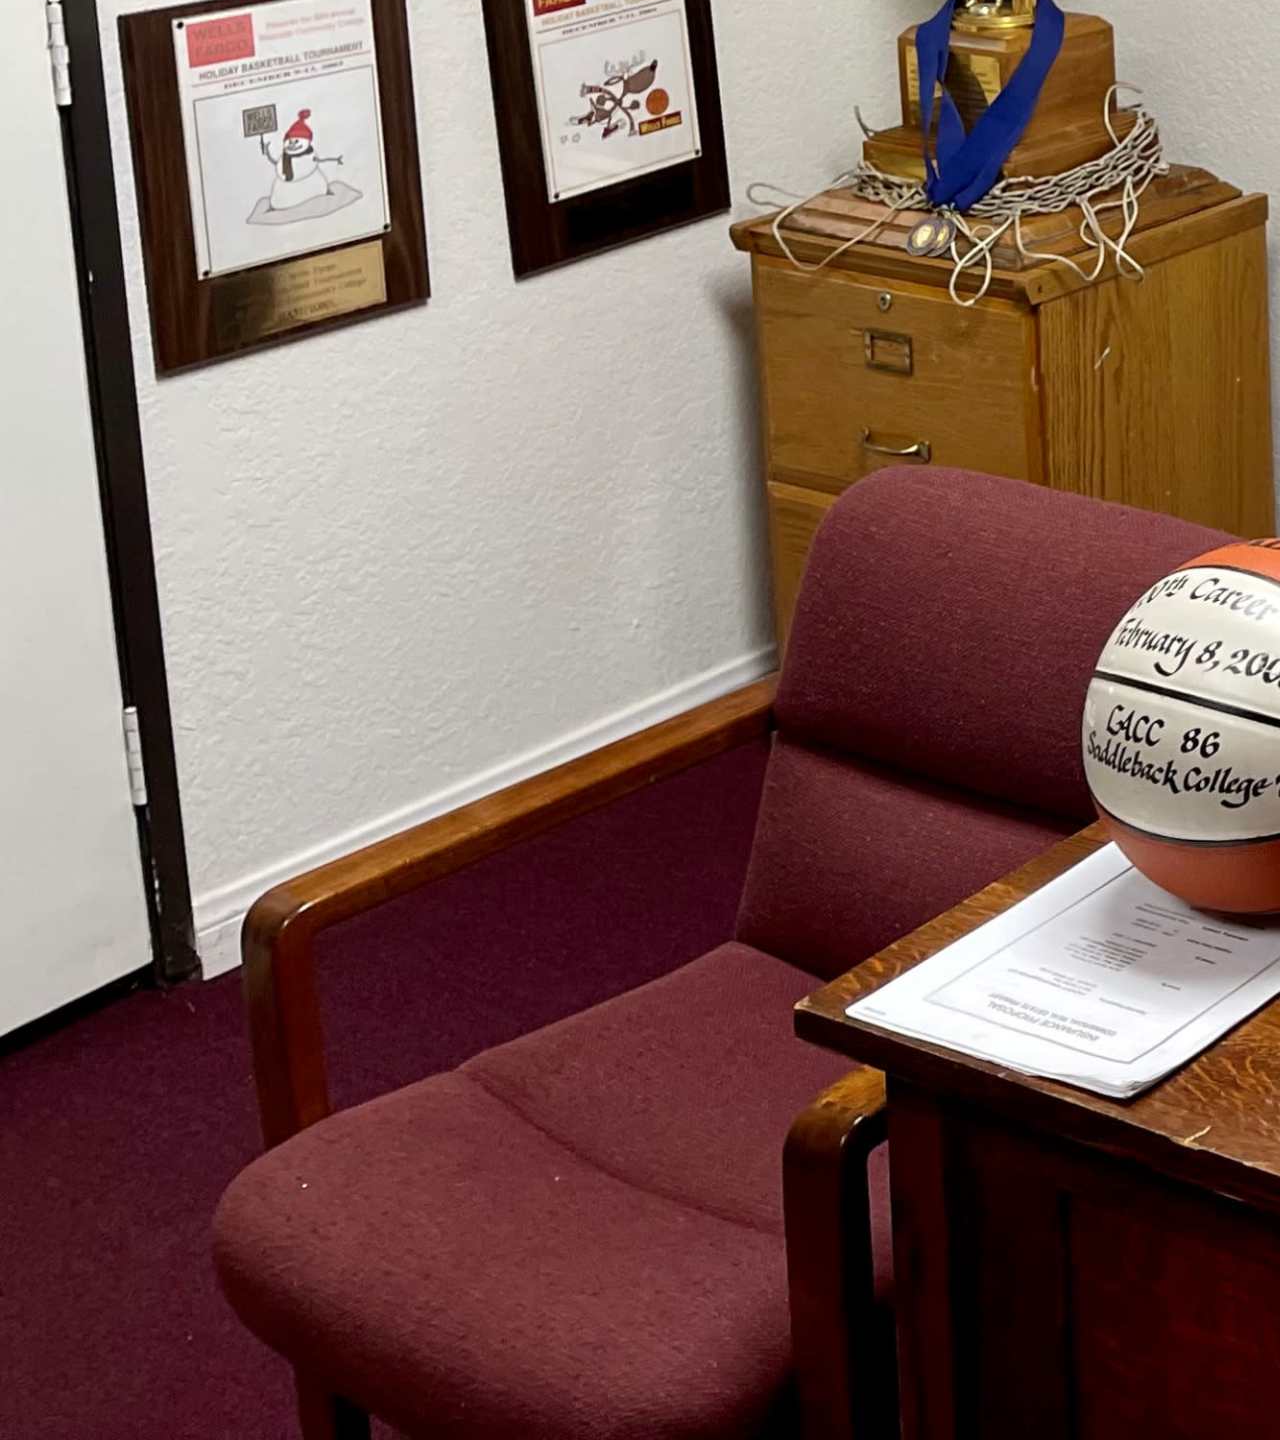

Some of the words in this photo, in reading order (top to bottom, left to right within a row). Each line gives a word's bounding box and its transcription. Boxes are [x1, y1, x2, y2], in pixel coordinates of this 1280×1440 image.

[198, 65, 239, 81] HOLIDAY
[241, 53, 301, 73] BASKETBALL
[303, 40, 364, 60] TOURNAMENT
[1190, 578, 1280, 621] Career
[1114, 618, 1198, 677] February
[1107, 705, 1165, 744] LACC
[1180, 729, 1220, 758] 86
[1088, 734, 1179, 793] Saddleback
[1184, 768, 1272, 808] College
